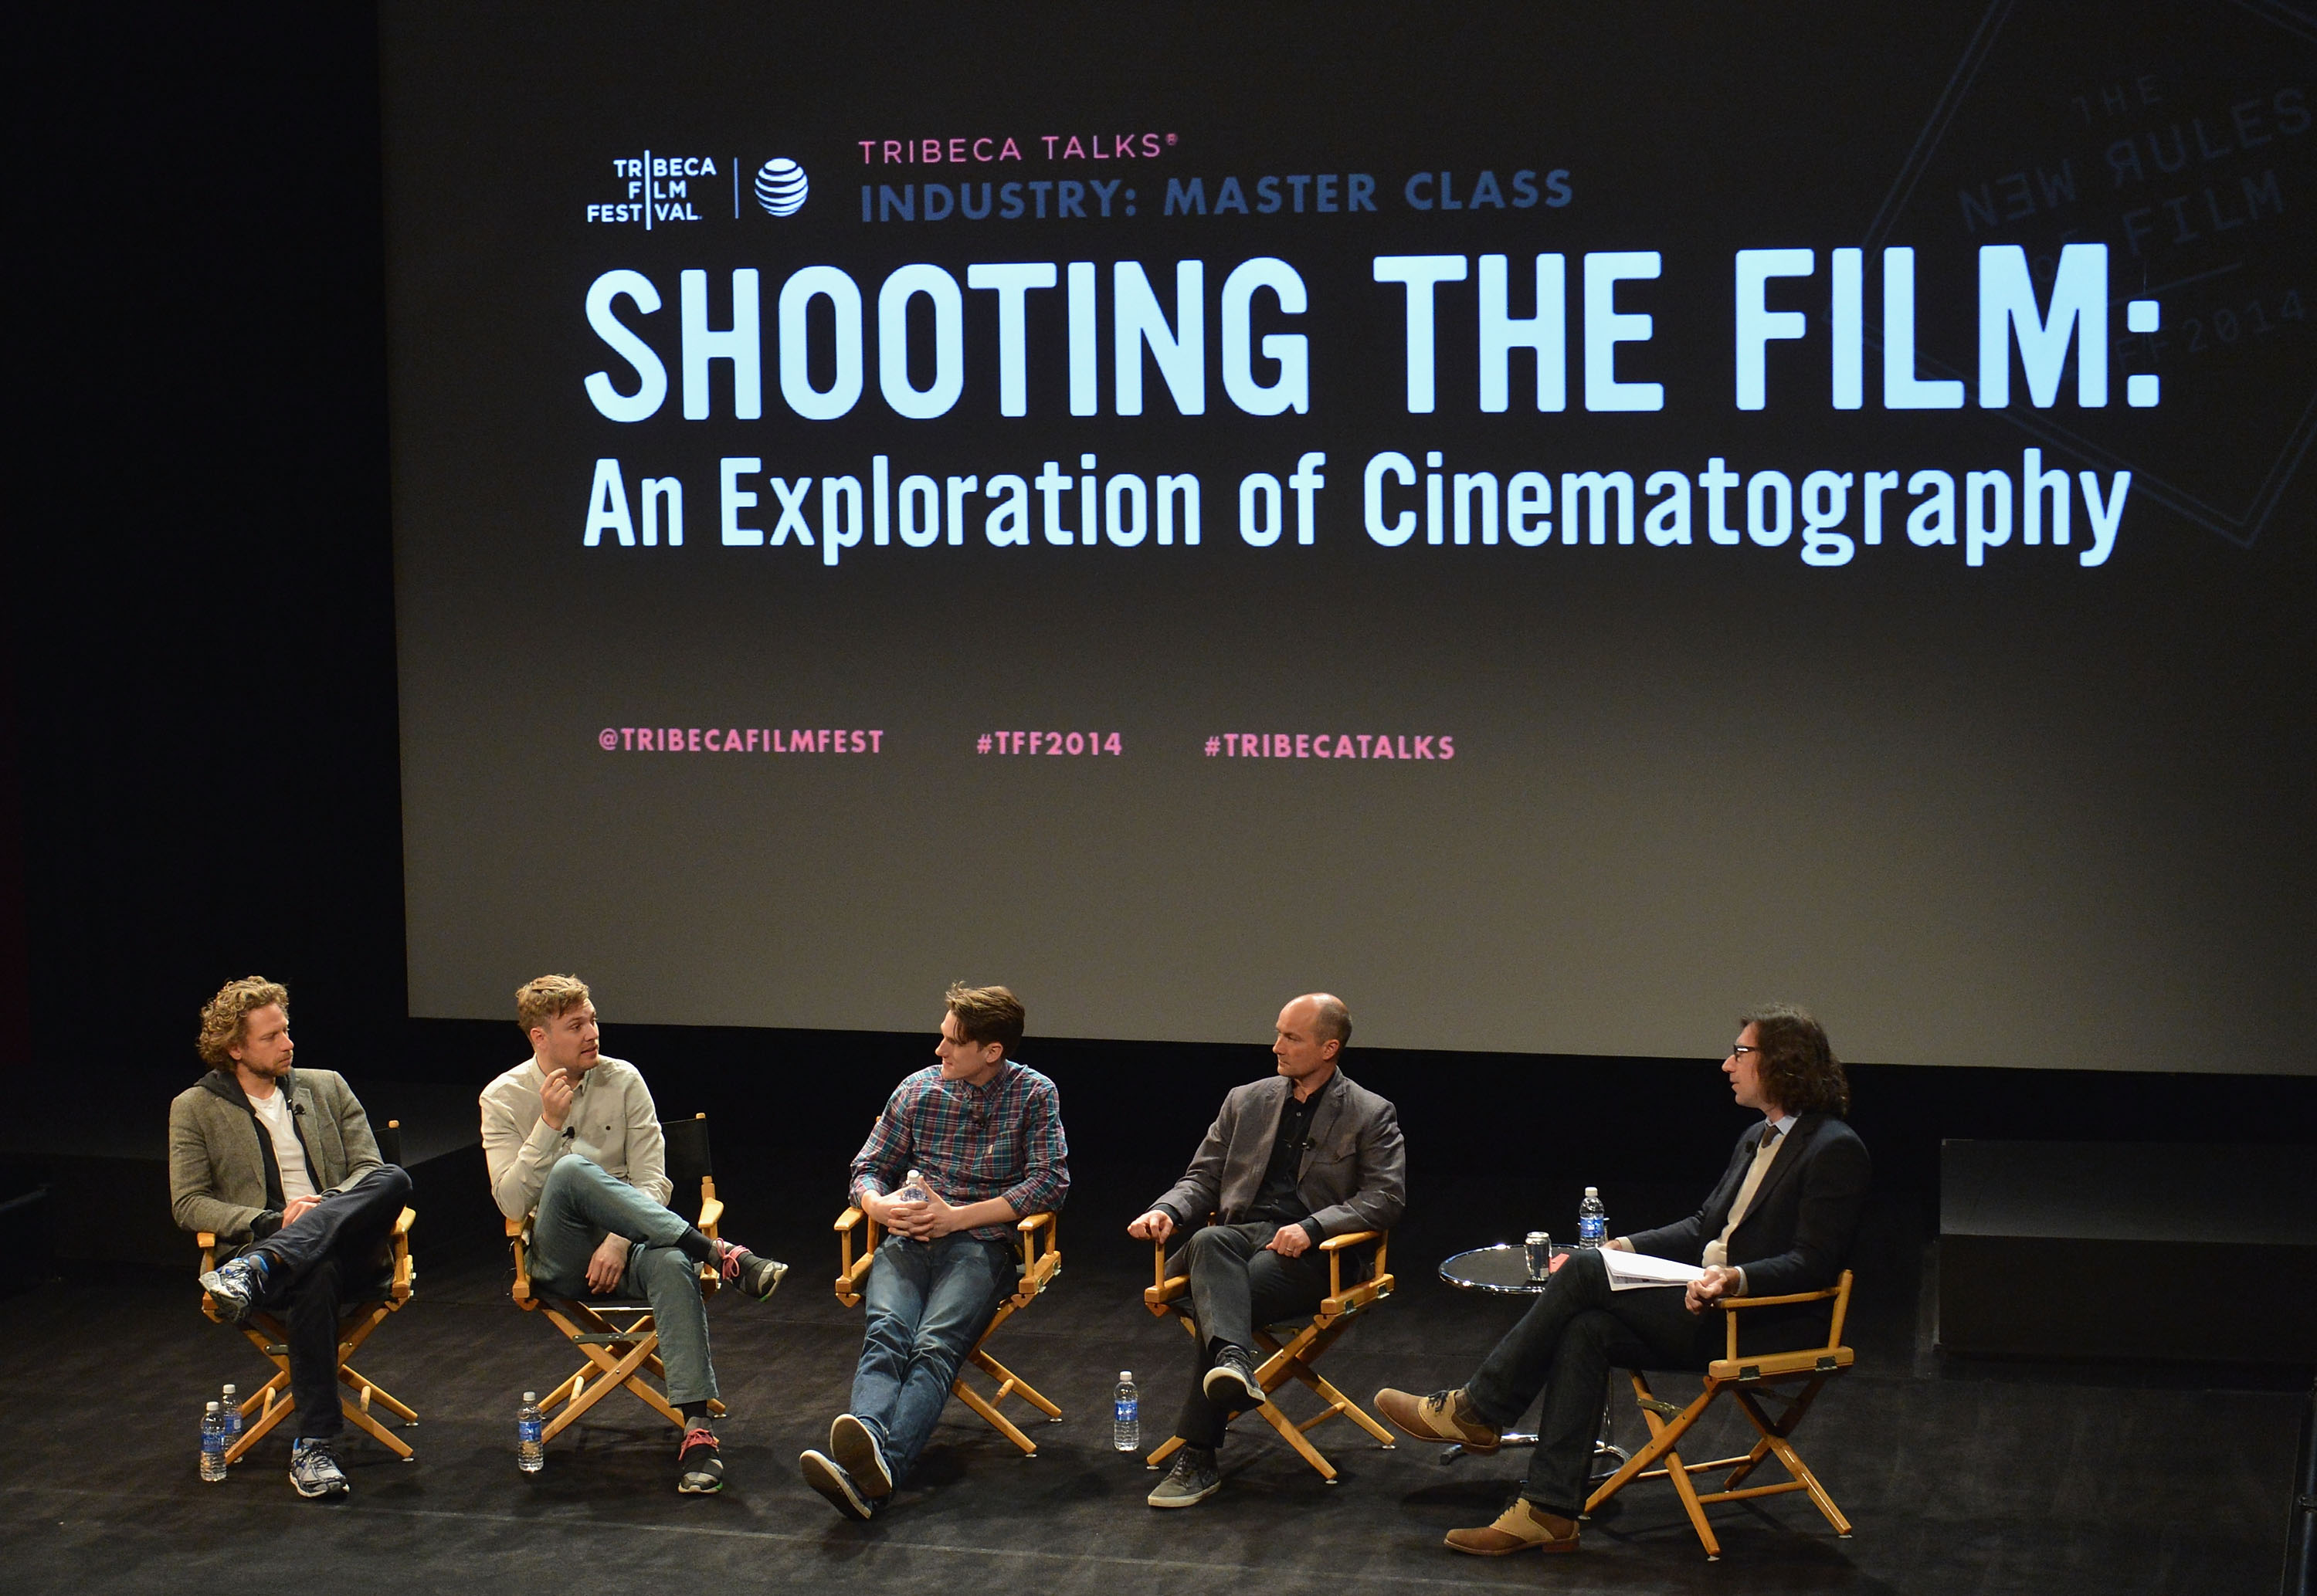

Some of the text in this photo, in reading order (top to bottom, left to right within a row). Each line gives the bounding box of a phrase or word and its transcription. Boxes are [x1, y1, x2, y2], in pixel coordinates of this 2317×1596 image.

[2071, 76, 2165, 126] THE
[613, 157, 717, 178] TRIBECA
[859, 137, 1022, 164] TRIBECA
[628, 180, 687, 200] FILM
[861, 168, 1572, 222] INDUSTRY: MASTER CLASS
[2121, 169, 2286, 257] FILM
[584, 243, 2161, 423] SHOOTING THE FILM:
[2057, 289, 2305, 381] FF2014
[583, 448, 2132, 568] An Exploration of Cinematography
[599, 727, 1455, 761] @TRIBECAFILMFEST #TFF2014 #TRIBECATALKS
